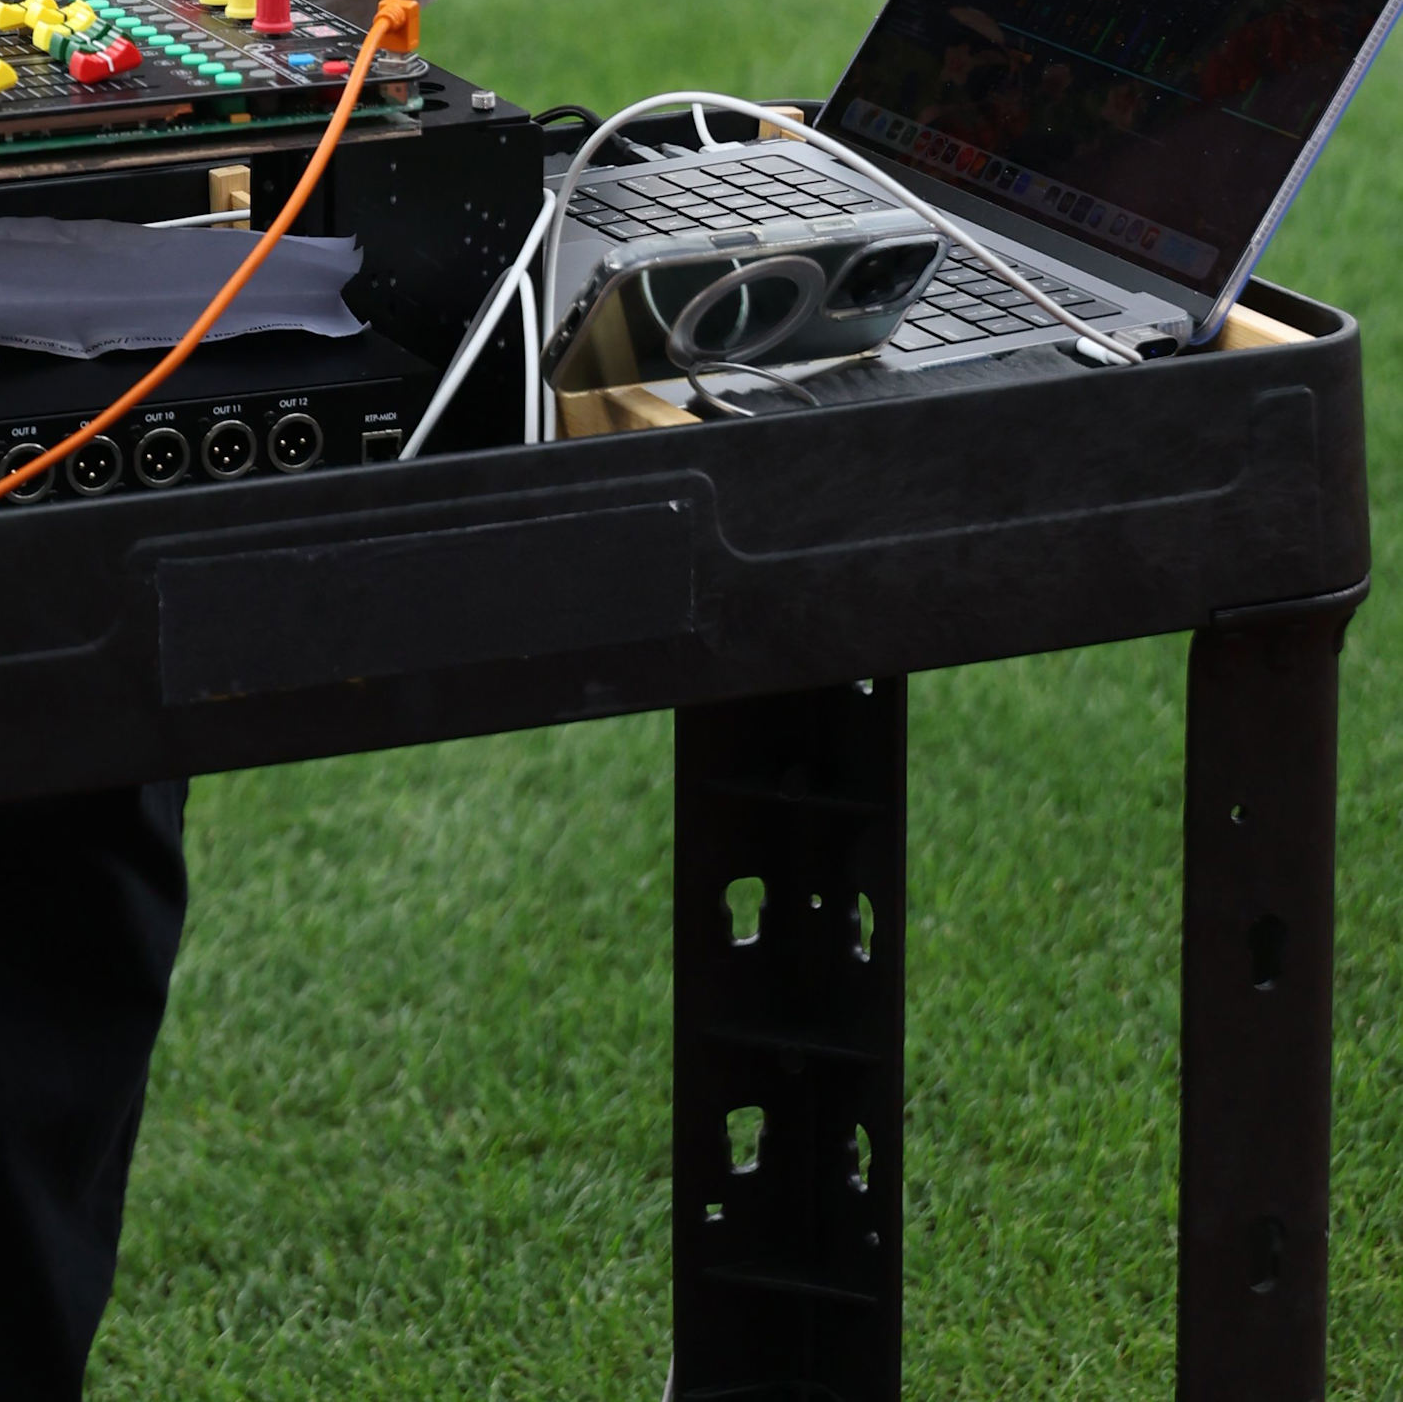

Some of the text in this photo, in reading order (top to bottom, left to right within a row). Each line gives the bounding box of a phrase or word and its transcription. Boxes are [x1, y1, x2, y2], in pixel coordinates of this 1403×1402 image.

[279, 397, 308, 408] OUT 12
[213, 404, 241, 415] OUT 11
[145, 411, 175, 423] OUT 10
[365, 412, 397, 423] RTP-MIDI
[11, 426, 37, 437] OUT 8
